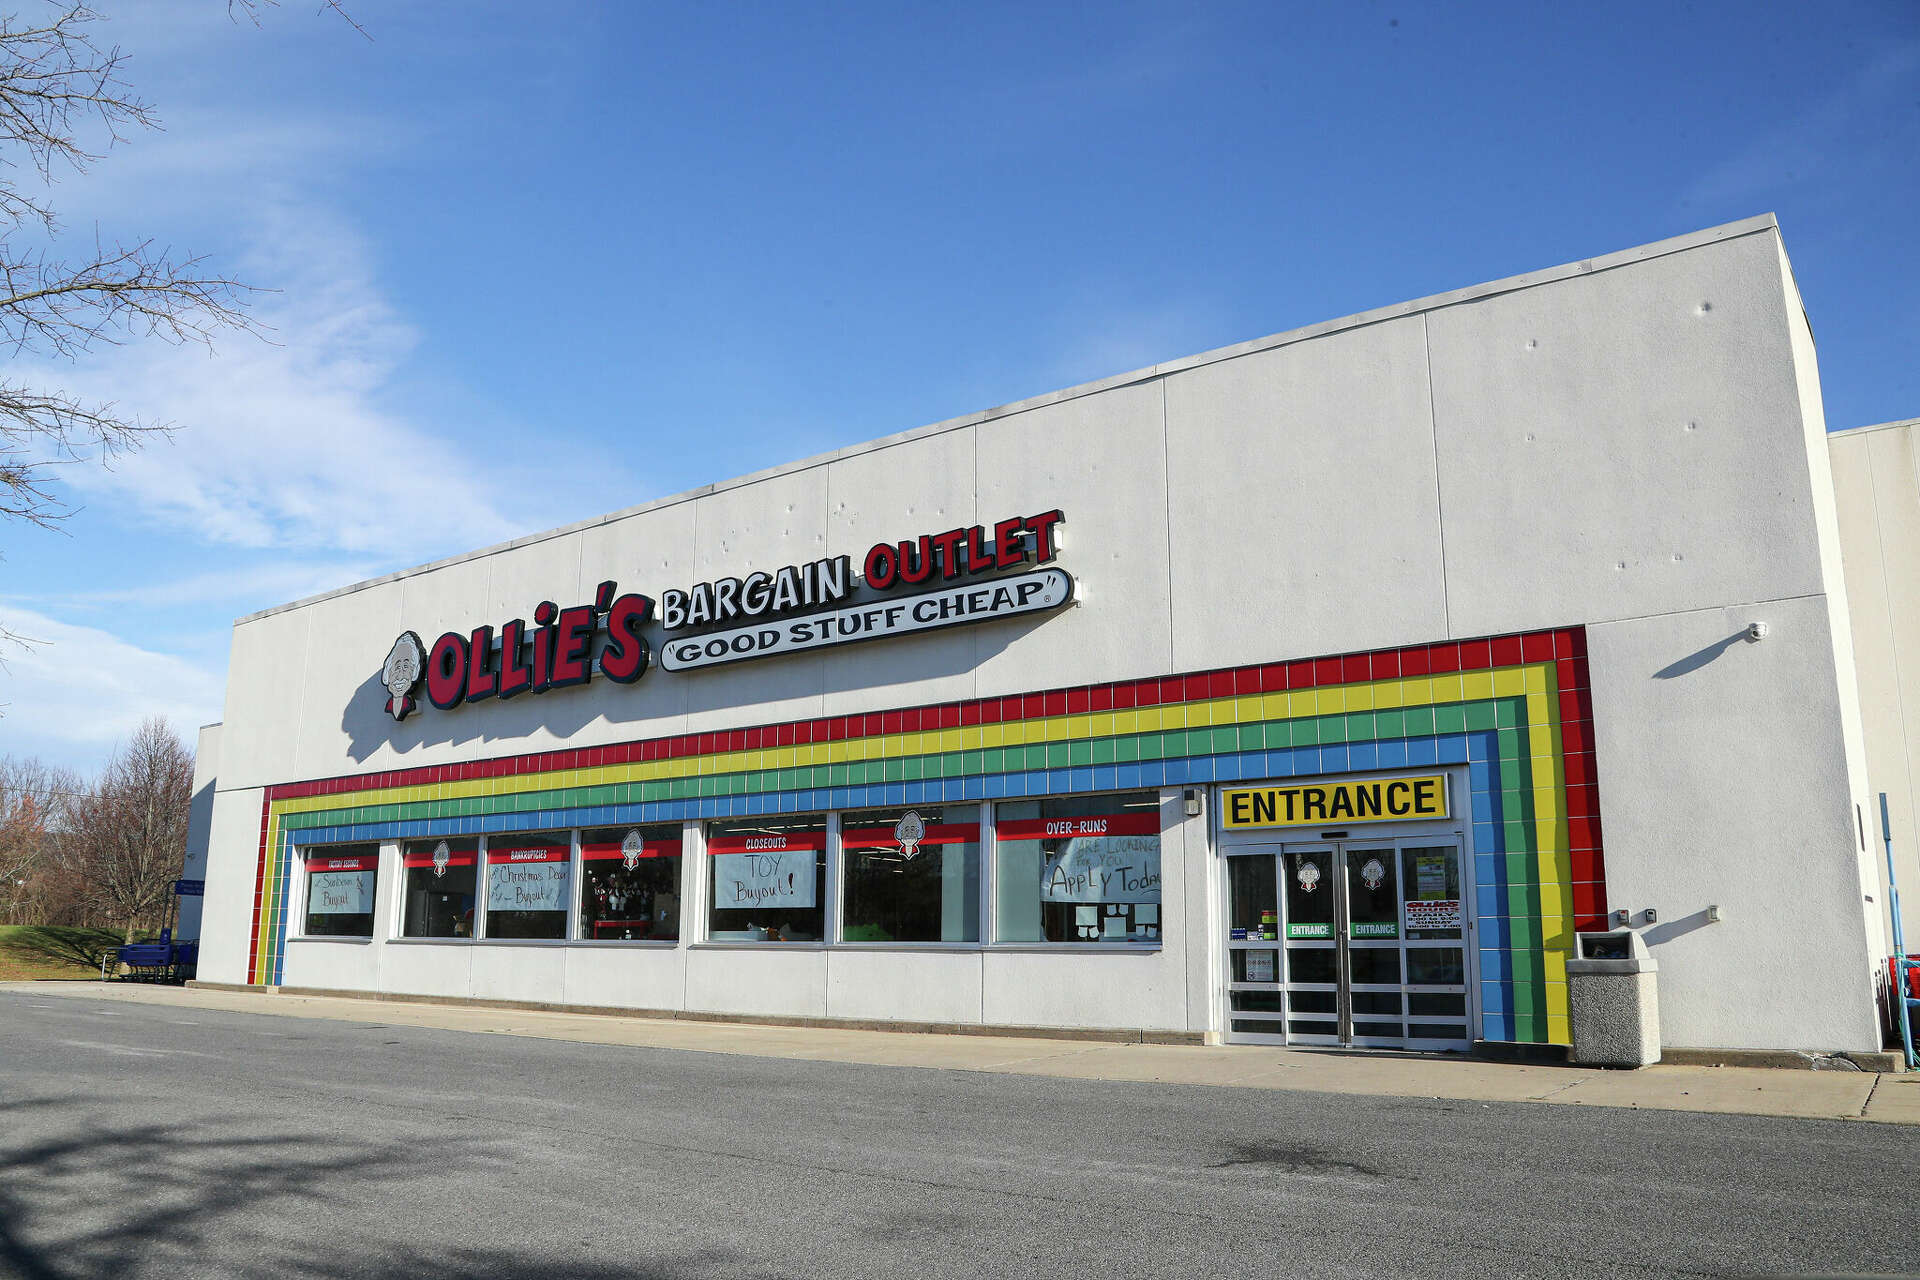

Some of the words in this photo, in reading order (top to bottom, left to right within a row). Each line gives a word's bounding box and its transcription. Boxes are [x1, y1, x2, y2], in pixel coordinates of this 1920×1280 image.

[662, 555, 850, 630] BARGAIN
[863, 508, 1066, 591] OUTLET
[667, 629, 781, 663] "GOOD
[789, 605, 907, 644] STUFF
[1230, 780, 1437, 825] ENTRANCE
[1046, 819, 1108, 835] OVER-RUNS
[745, 837, 787, 850] CLOSEOUTS
[743, 854, 783, 879] TOY
[1291, 924, 1330, 935] ENTRANCE
[1355, 923, 1396, 934] ENTRANCE
